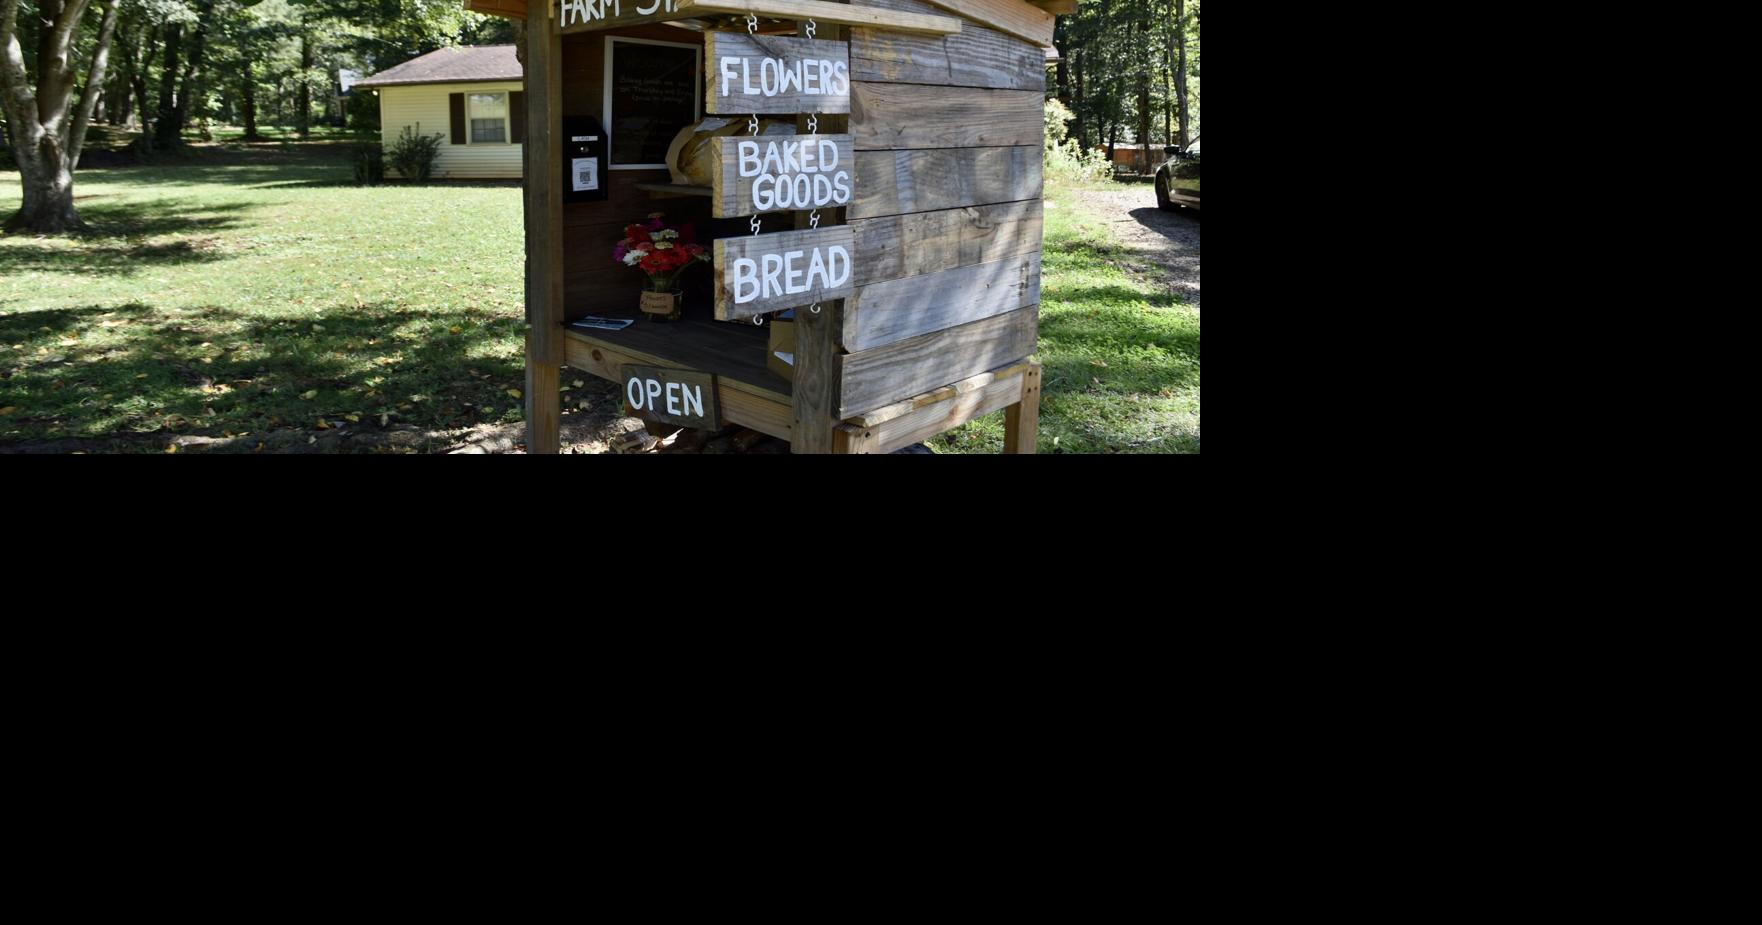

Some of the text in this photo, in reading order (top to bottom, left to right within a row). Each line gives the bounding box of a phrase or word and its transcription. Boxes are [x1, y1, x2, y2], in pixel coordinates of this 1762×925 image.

[720, 57, 850, 97] FLOWERS
[738, 140, 839, 177] BAKED
[752, 171, 850, 211] GOODS
[733, 245, 850, 304] BREAD
[627, 377, 704, 418] OPEN
